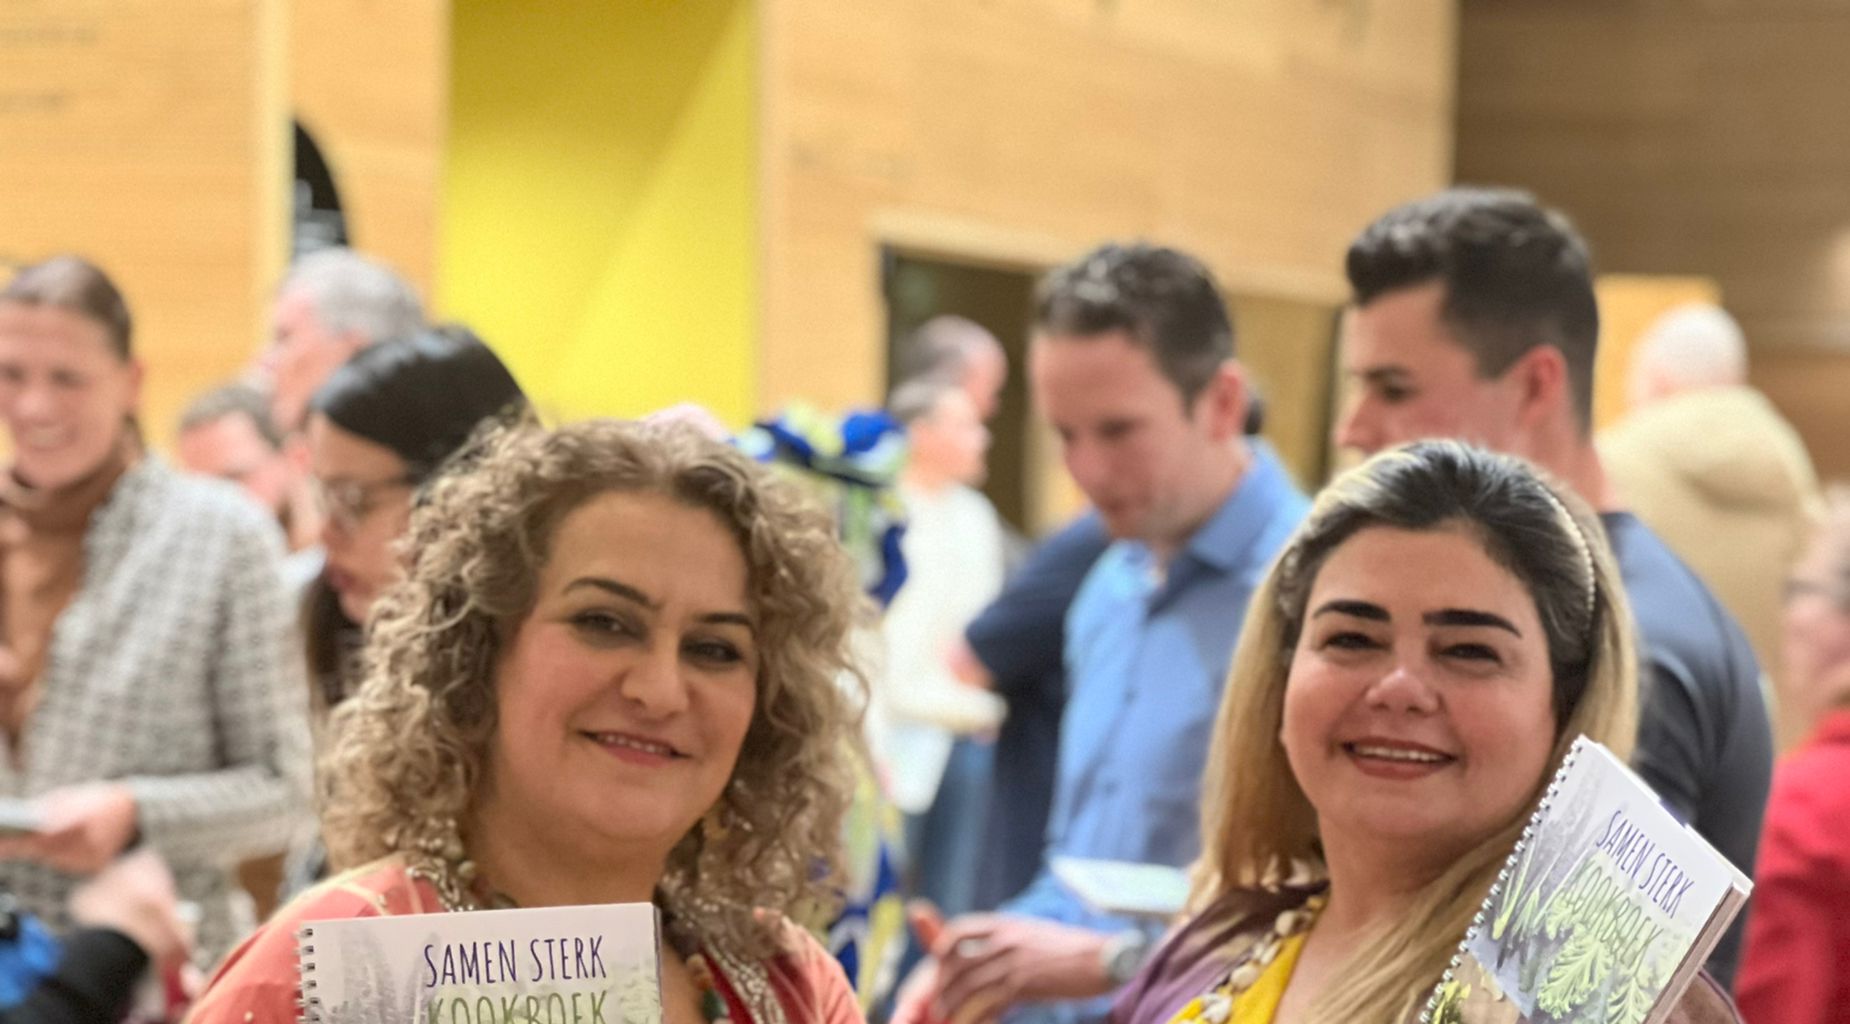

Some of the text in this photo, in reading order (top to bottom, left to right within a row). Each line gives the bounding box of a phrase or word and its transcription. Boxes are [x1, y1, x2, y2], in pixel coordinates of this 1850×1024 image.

[1563, 859, 1664, 976] KOOKBOEK
[1596, 810, 1695, 919] SAMEN STERK
[424, 935, 606, 988] SAMEN STERK
